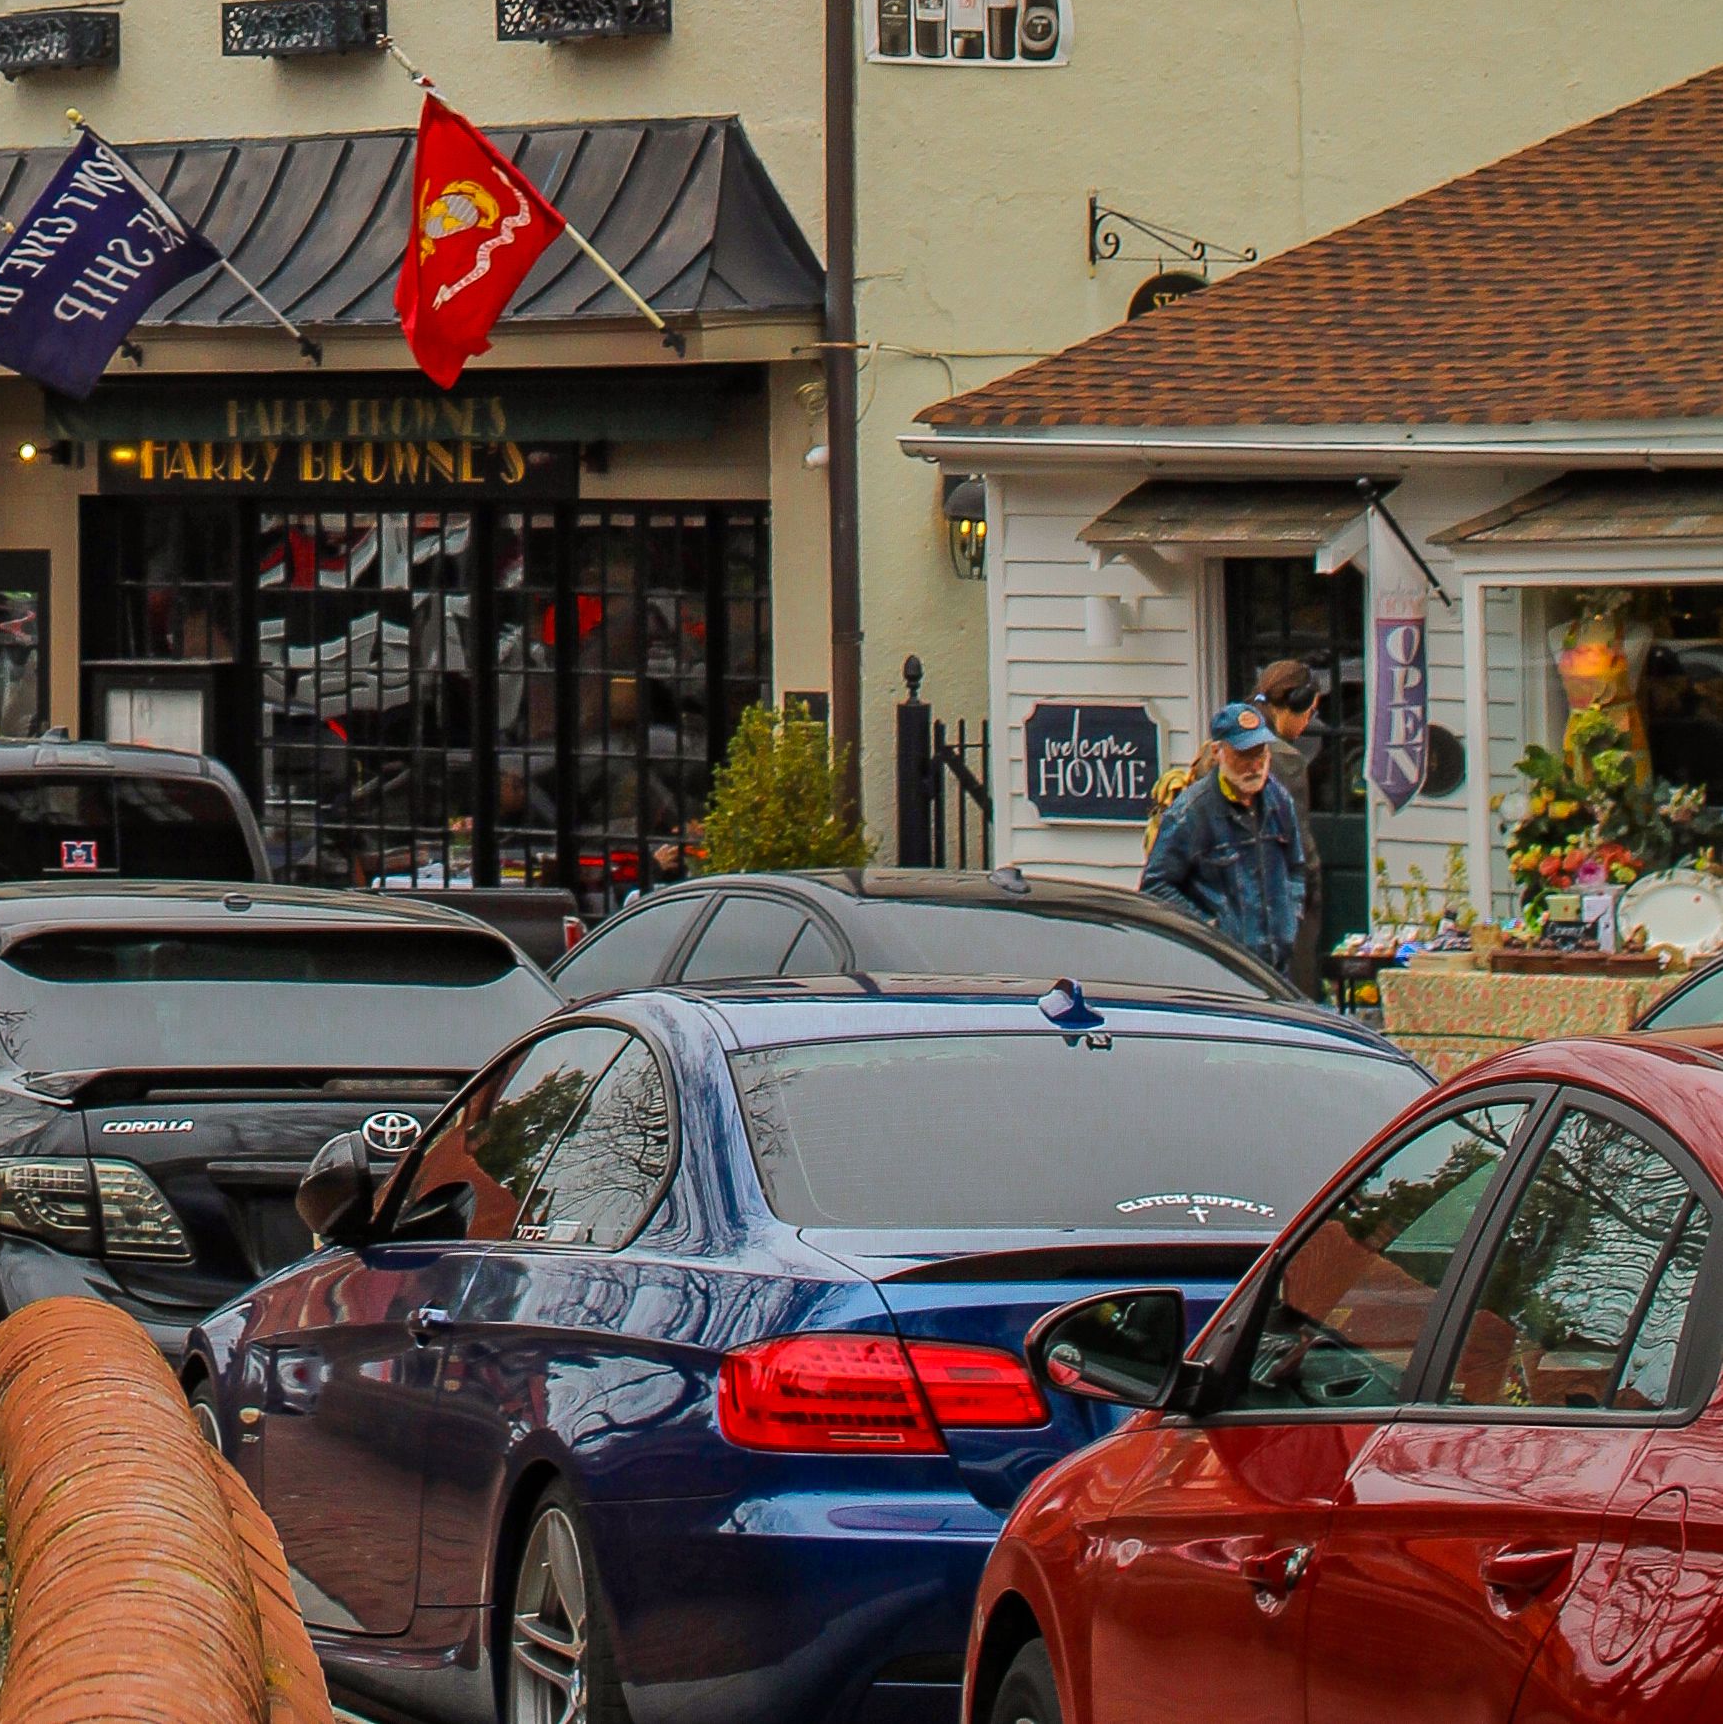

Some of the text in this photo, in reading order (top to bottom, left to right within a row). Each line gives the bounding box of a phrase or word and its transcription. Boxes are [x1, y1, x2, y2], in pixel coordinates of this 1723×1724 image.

[139, 439, 526, 484] HARRY BROWNE'S
[1382, 624, 1424, 786] OPEN
[1045, 708, 1138, 776] welcome
[1039, 758, 1147, 799] HOME
[102, 1120, 194, 1133] COROLLA
[1116, 1194, 1190, 1213] CLUTCH
